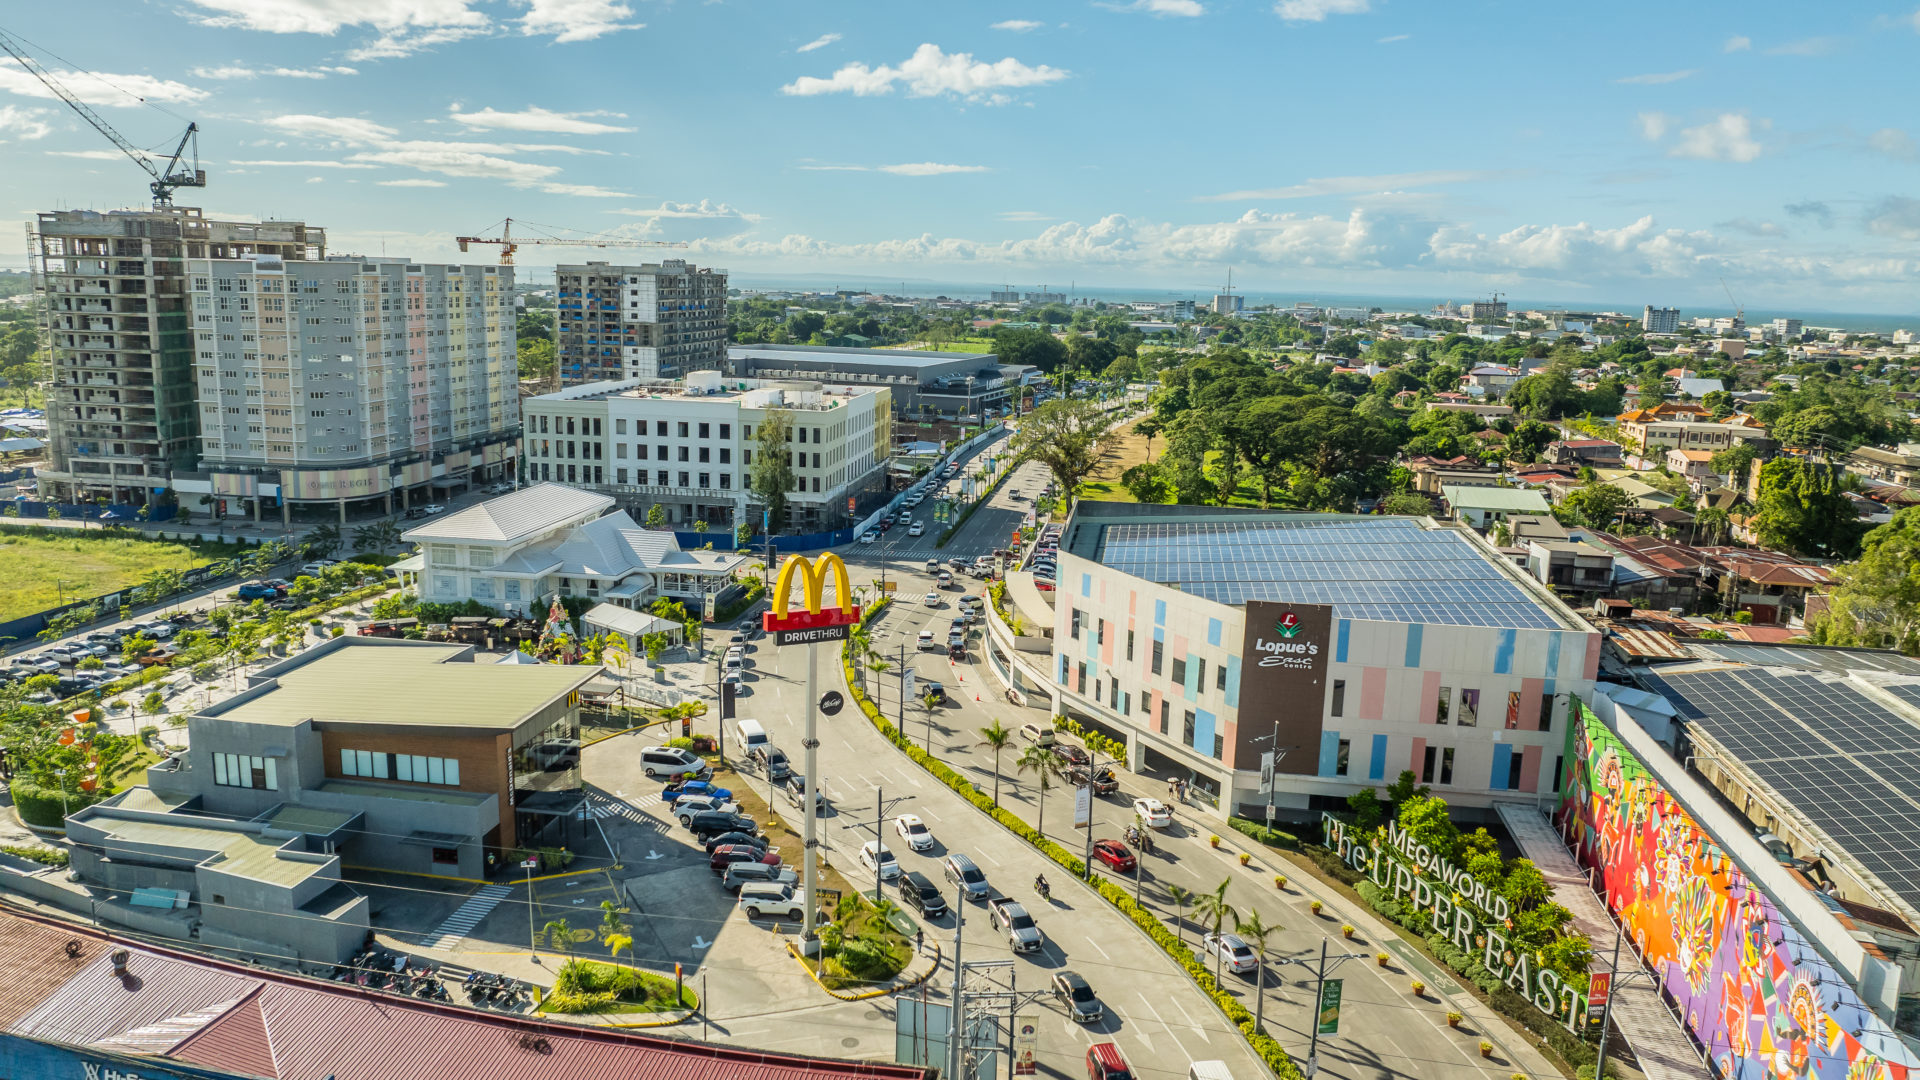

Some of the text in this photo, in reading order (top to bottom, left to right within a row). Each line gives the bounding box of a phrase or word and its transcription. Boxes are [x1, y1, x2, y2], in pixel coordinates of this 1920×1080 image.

[785, 628, 843, 642] DRIVETHRU
[1255, 638, 1319, 655] Lopue's
[1258, 655, 1312, 667] East
[1388, 819, 1510, 921] MEGAWORLD
[1321, 811, 1580, 1036] The UPPER EAST
